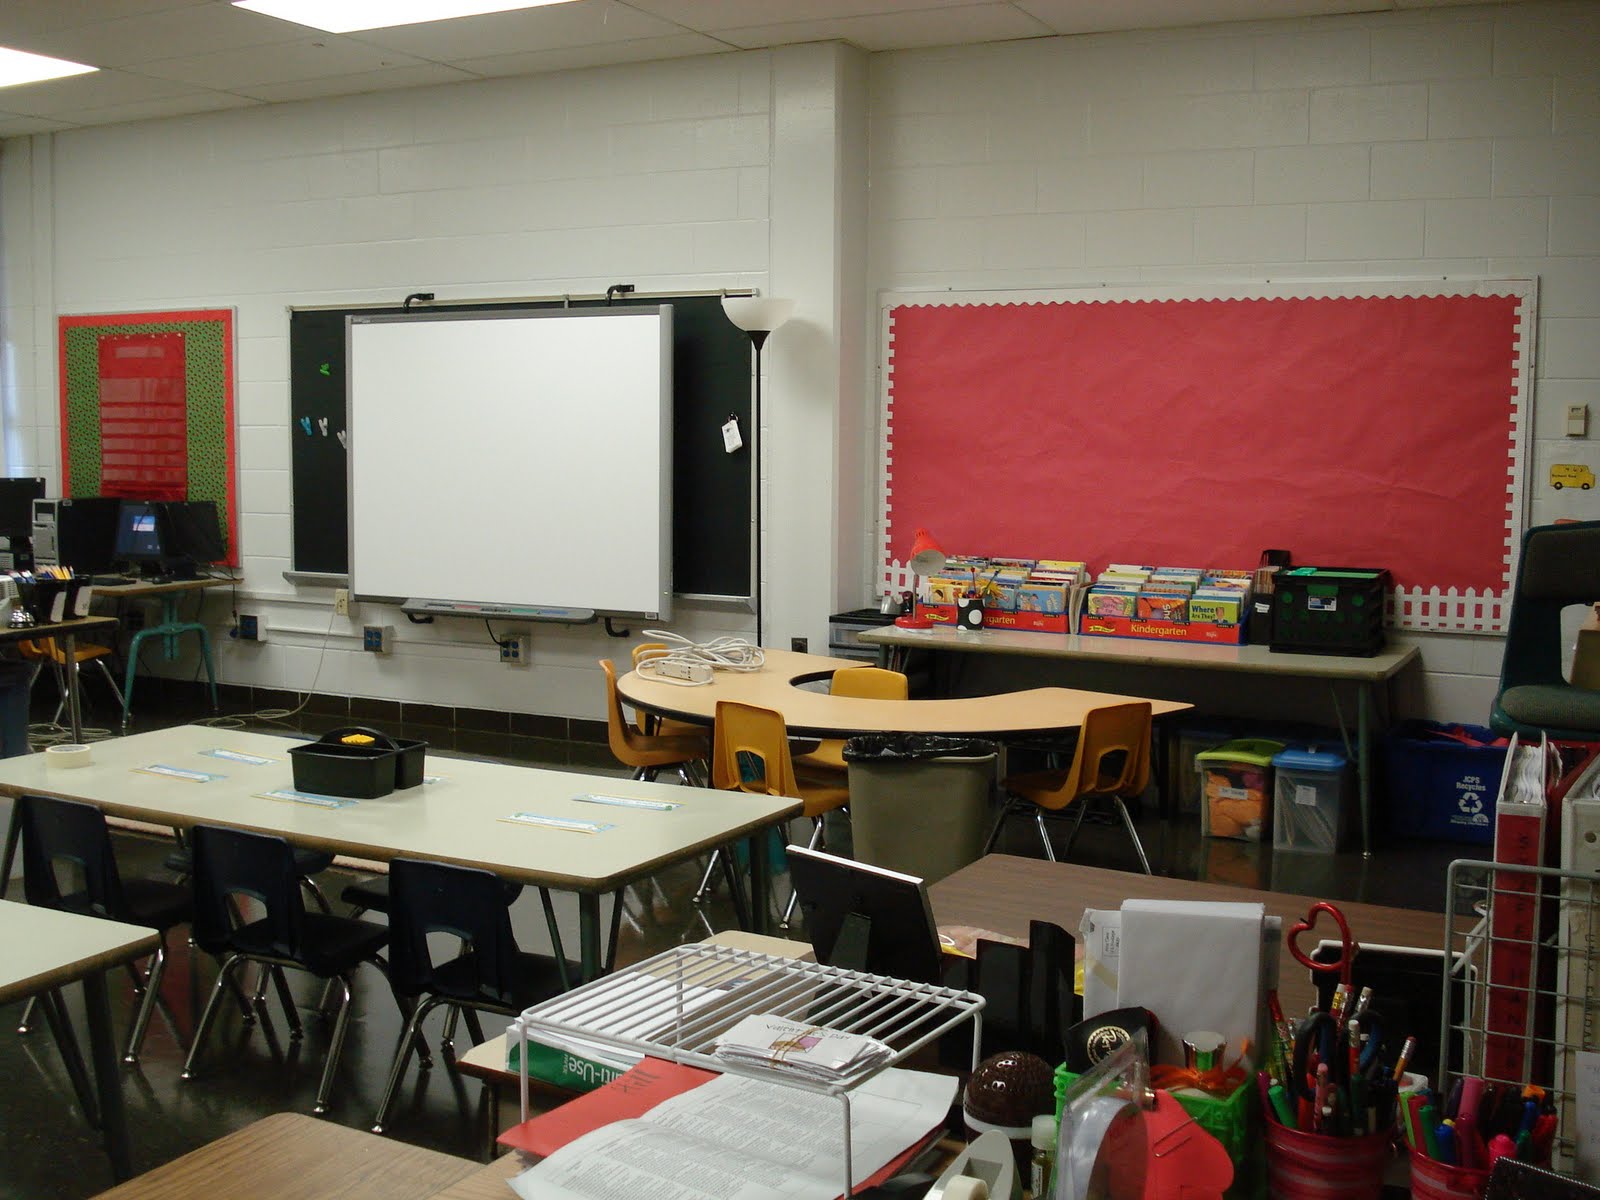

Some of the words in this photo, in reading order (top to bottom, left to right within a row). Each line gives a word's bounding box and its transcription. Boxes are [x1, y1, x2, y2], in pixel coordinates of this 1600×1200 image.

[1192, 605, 1215, 614] Where
[984, 616, 1016, 626] rgarten
[1131, 623, 1187, 637] Kindergarten
[1463, 776, 1480, 784] JCPS
[1456, 782, 1486, 791] Recycles
